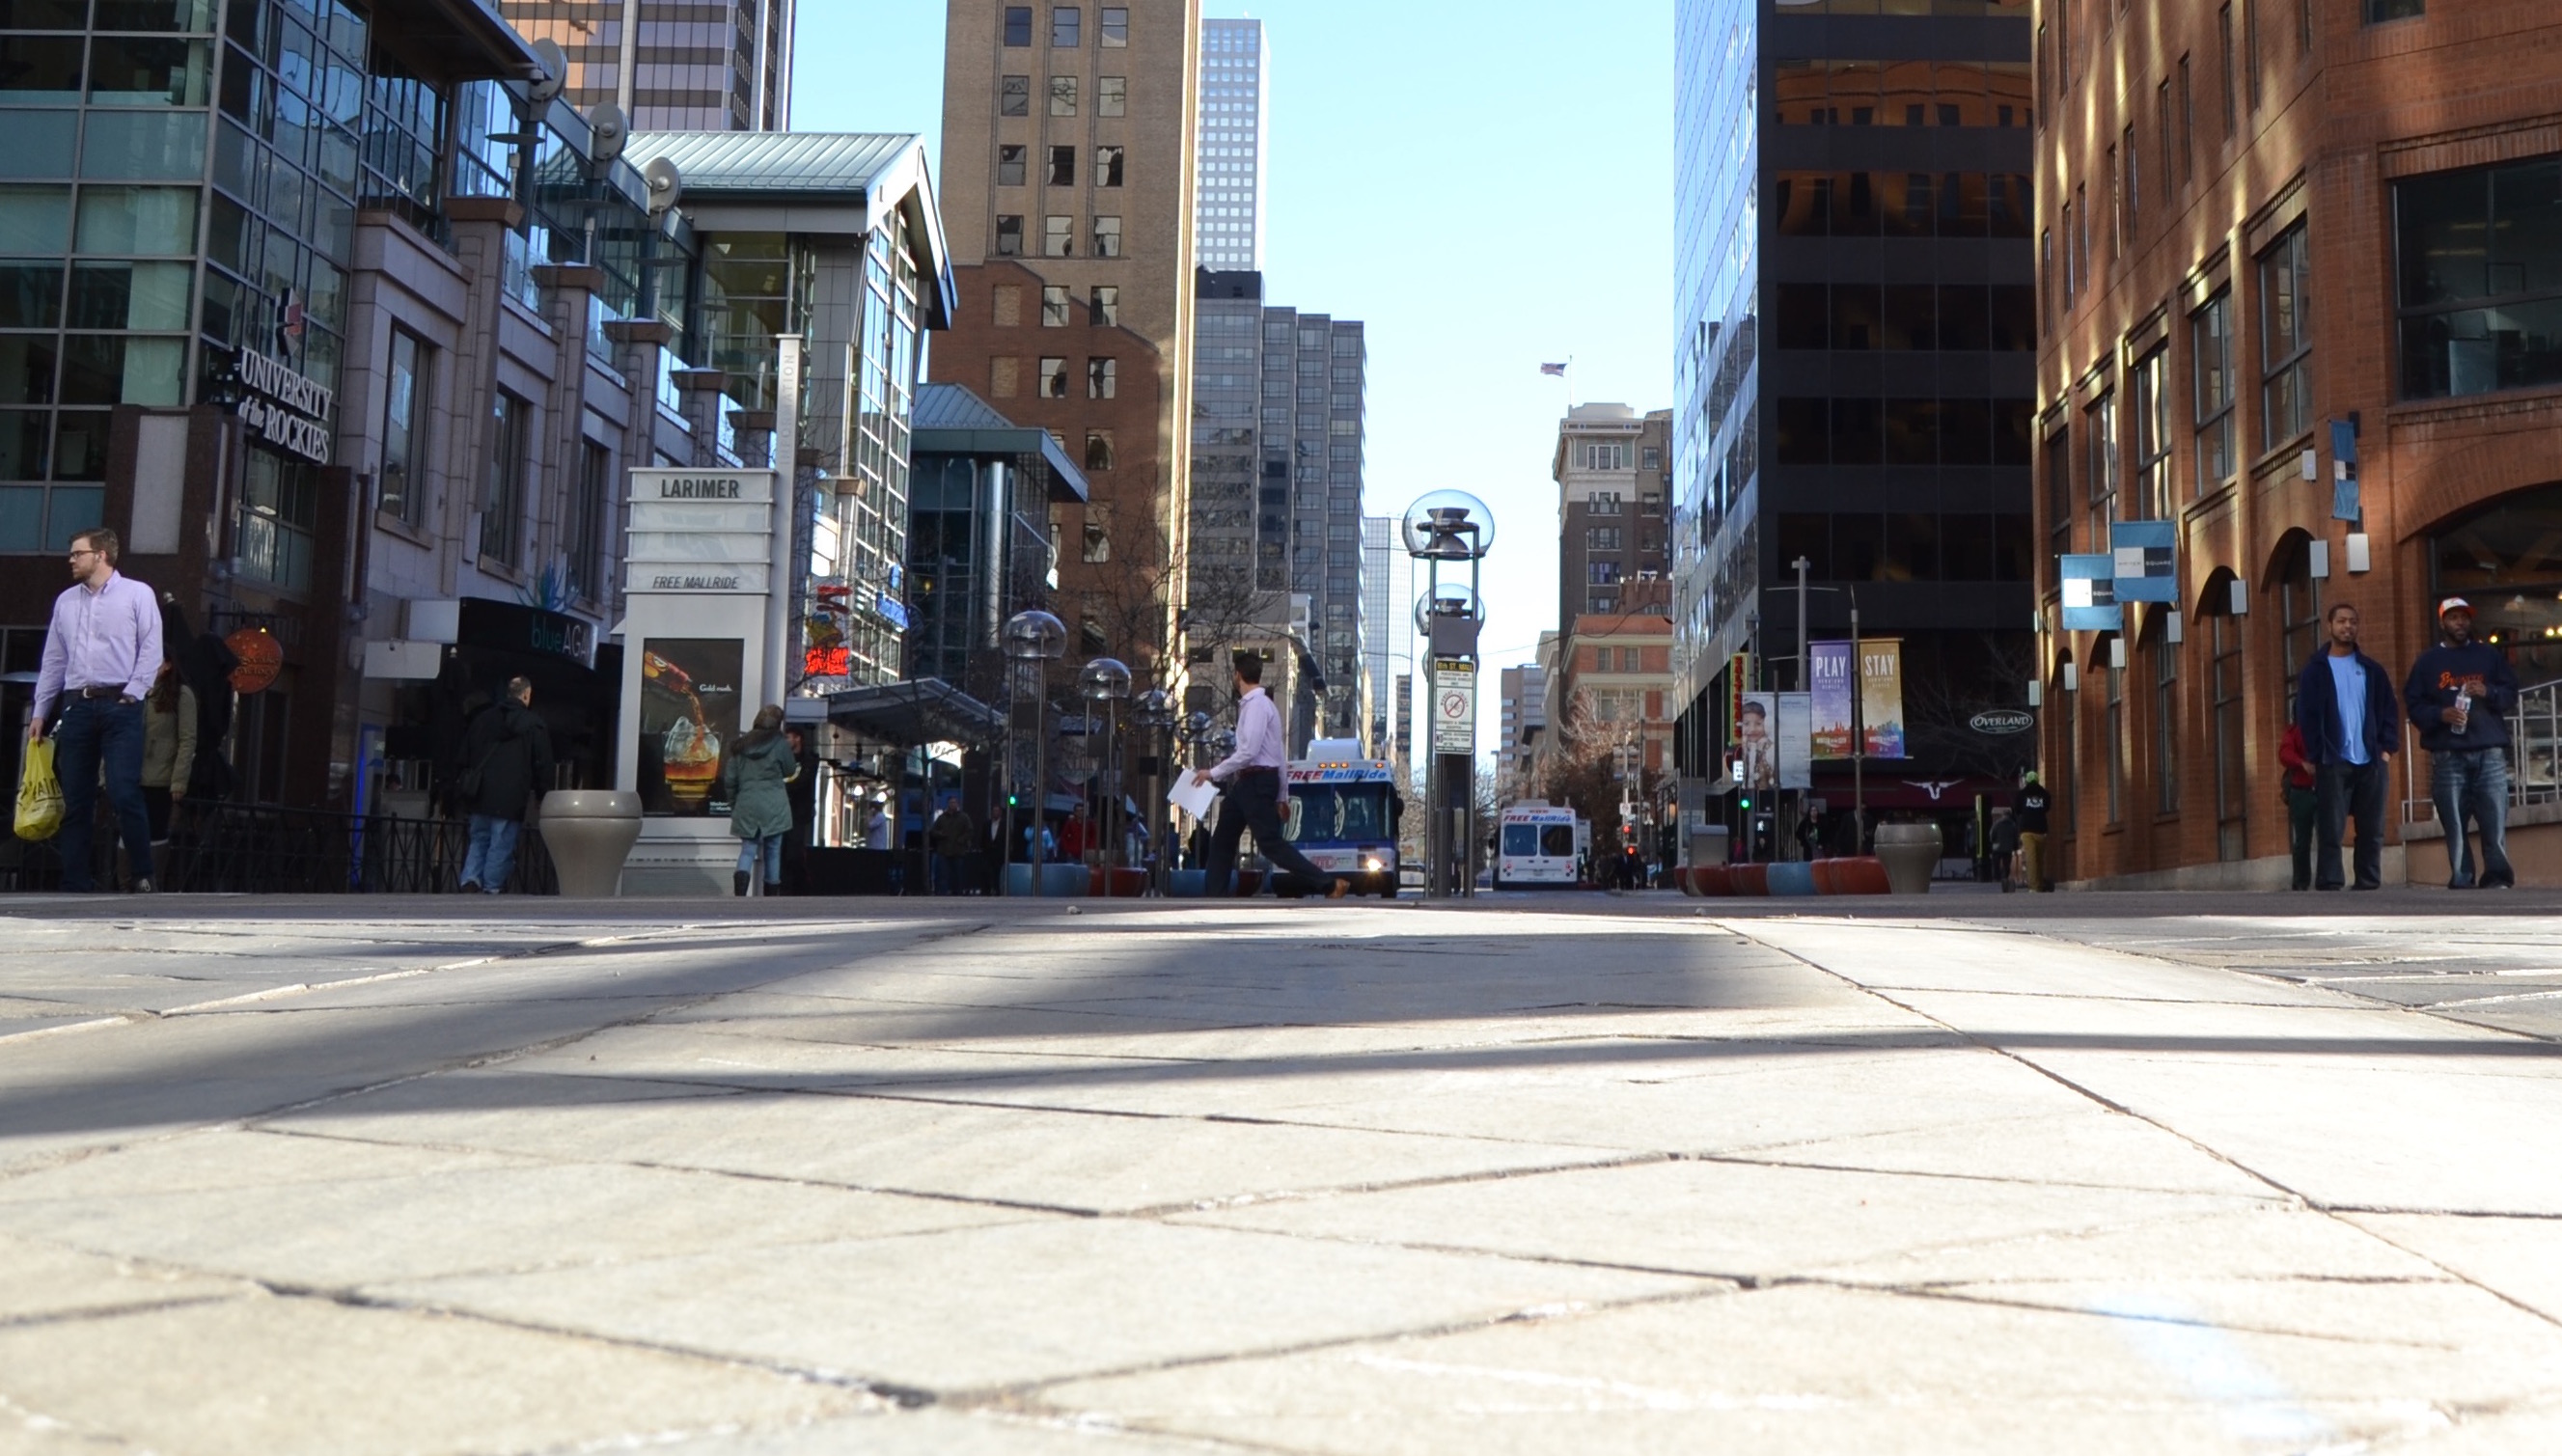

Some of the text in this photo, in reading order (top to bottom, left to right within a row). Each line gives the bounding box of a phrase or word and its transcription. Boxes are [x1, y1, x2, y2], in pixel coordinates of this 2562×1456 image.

[240, 345, 333, 422] UNIVERSITY
[263, 403, 329, 464] ROCKIES
[661, 479, 740, 498] LARIMER
[652, 576, 740, 589] FREE MALLRIDE
[1816, 656, 1846, 677] PLAY
[1864, 655, 1895, 676] STAY
[1974, 716, 2029, 727] OVERLAND
